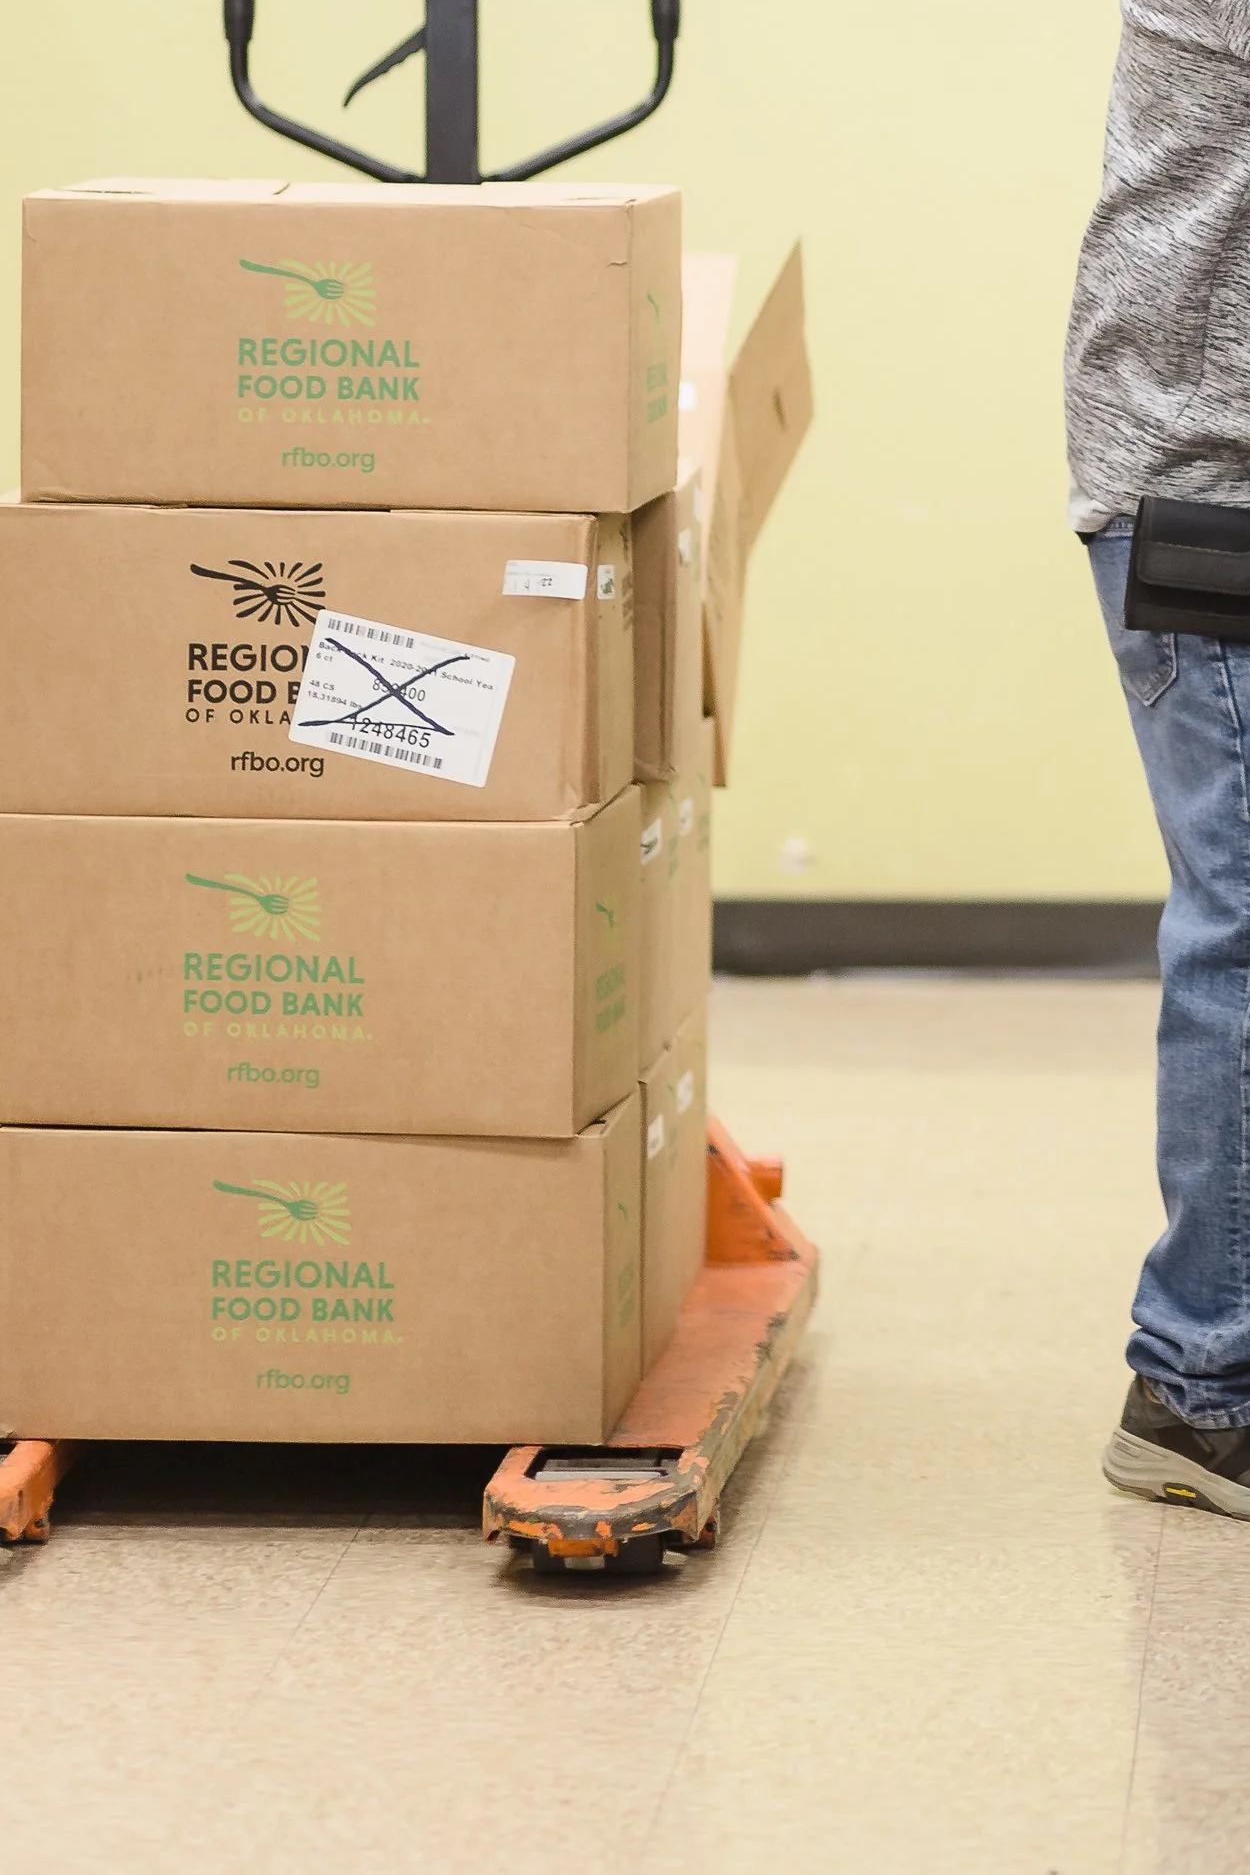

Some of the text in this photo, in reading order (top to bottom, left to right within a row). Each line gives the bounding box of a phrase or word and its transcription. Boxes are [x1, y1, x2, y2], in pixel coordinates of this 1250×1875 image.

[238, 338, 420, 368] REGIONAL
[238, 375, 420, 400] FOOD BANK
[238, 408, 422, 424] OF OKLAHOMA
[281, 446, 375, 473] rfbo.org
[188, 643, 309, 672] REGIO
[188, 679, 277, 704] FOOD
[441, 671, 473, 685] School
[186, 708, 291, 725] OF OKLA
[351, 713, 432, 748] 1248465
[231, 751, 324, 777] rfbo.org
[184, 953, 365, 984] REGIONAL
[183, 989, 364, 1017] FOOD BANK
[183, 1021, 367, 1040] OF OKLAHOMA
[227, 1061, 321, 1089] rfbo.org
[212, 1259, 395, 1289] REGIONAL
[212, 1296, 395, 1323] FOOD BANK
[211, 1326, 397, 1344] OF OKLAHOMA
[256, 1368, 350, 1395] rfbo.org
